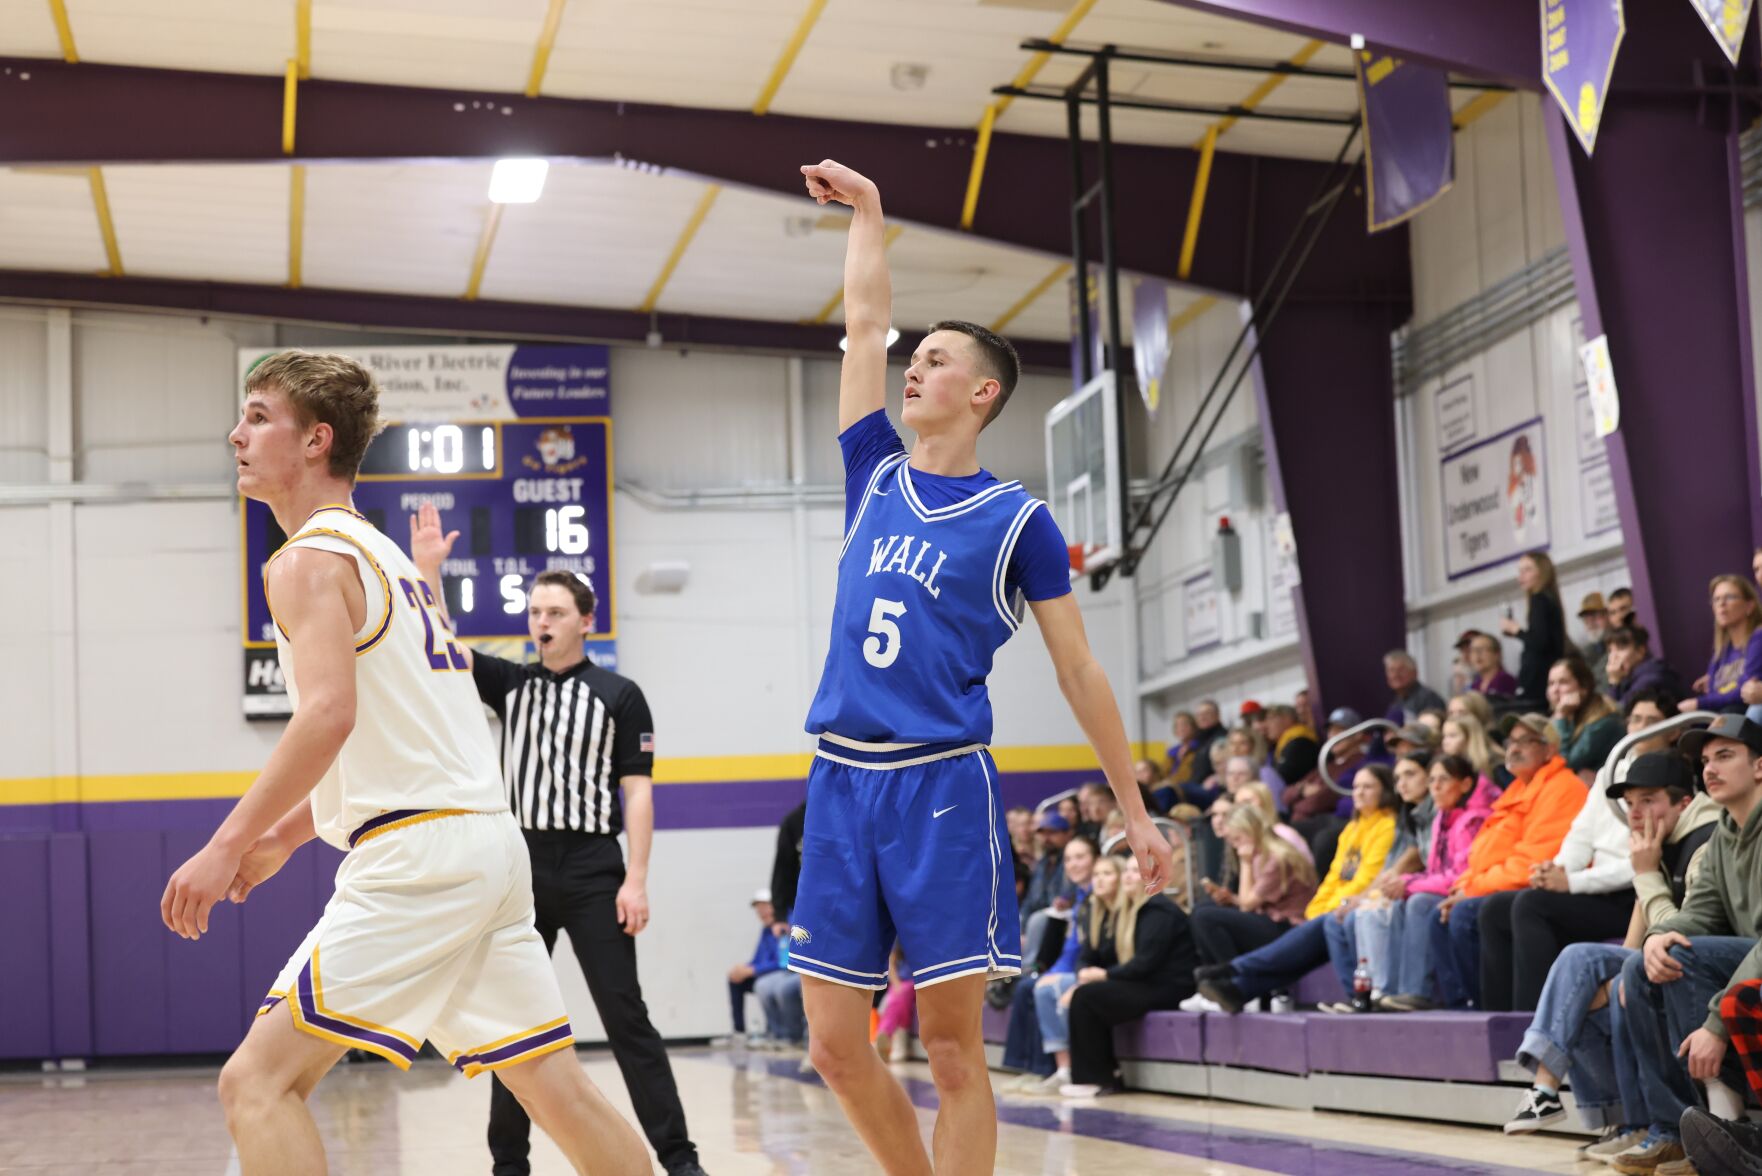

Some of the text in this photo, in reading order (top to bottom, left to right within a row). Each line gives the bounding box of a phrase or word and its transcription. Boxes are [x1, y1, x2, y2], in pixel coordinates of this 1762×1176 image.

[370, 354, 421, 371] River
[427, 353, 501, 370] Electric
[511, 365, 606, 381] Investing in our
[434, 376, 469, 391] Inc.
[512, 384, 606, 400] Future Leaders
[408, 424, 495, 473] 1:01
[512, 477, 583, 502] GUEST
[545, 504, 589, 555] 16
[866, 535, 947, 600] WALL
[460, 577, 475, 614] 1
[862, 597, 908, 669] 5
